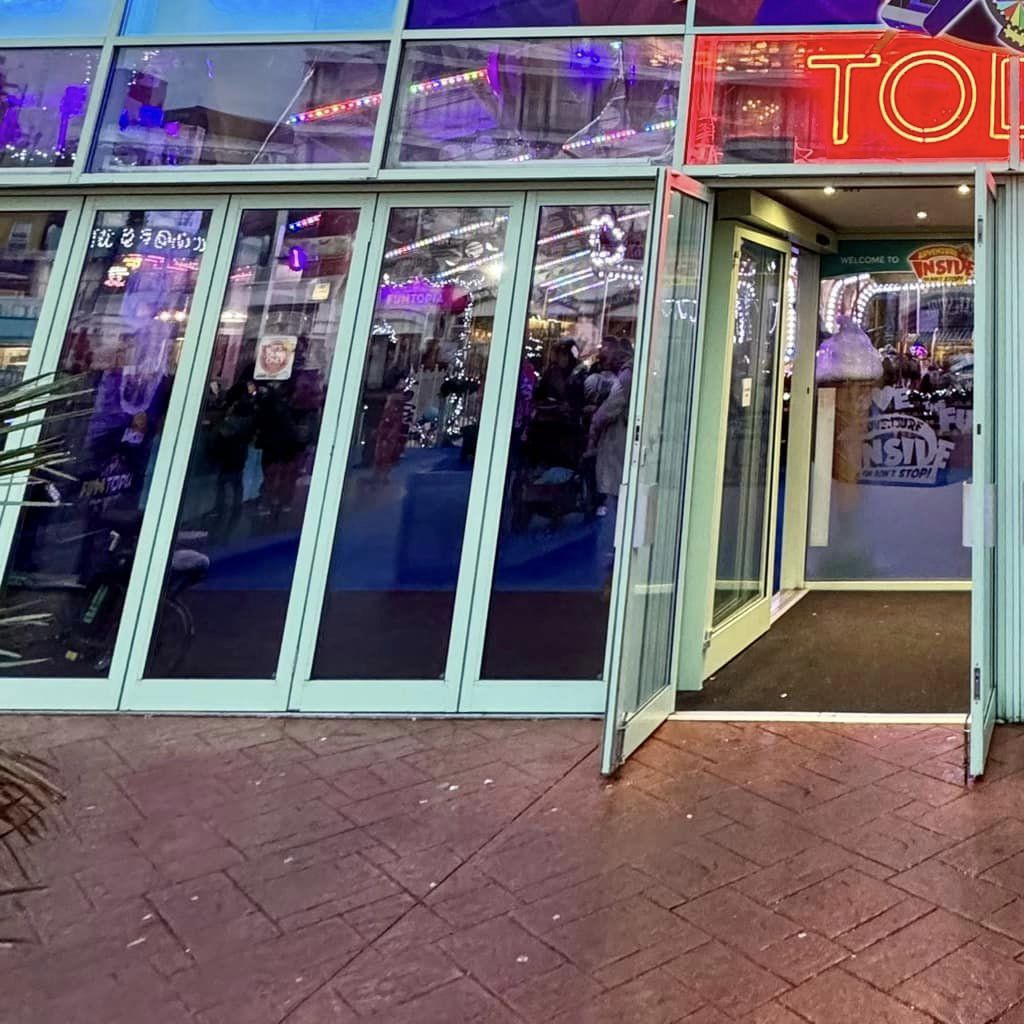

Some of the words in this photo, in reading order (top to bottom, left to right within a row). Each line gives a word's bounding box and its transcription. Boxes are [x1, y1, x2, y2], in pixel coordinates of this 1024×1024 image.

[840, 256, 884, 264] WELCOME
[888, 255, 900, 264] TO
[861, 435, 955, 469] NSIDE
[898, 467, 932, 479] STOP!
